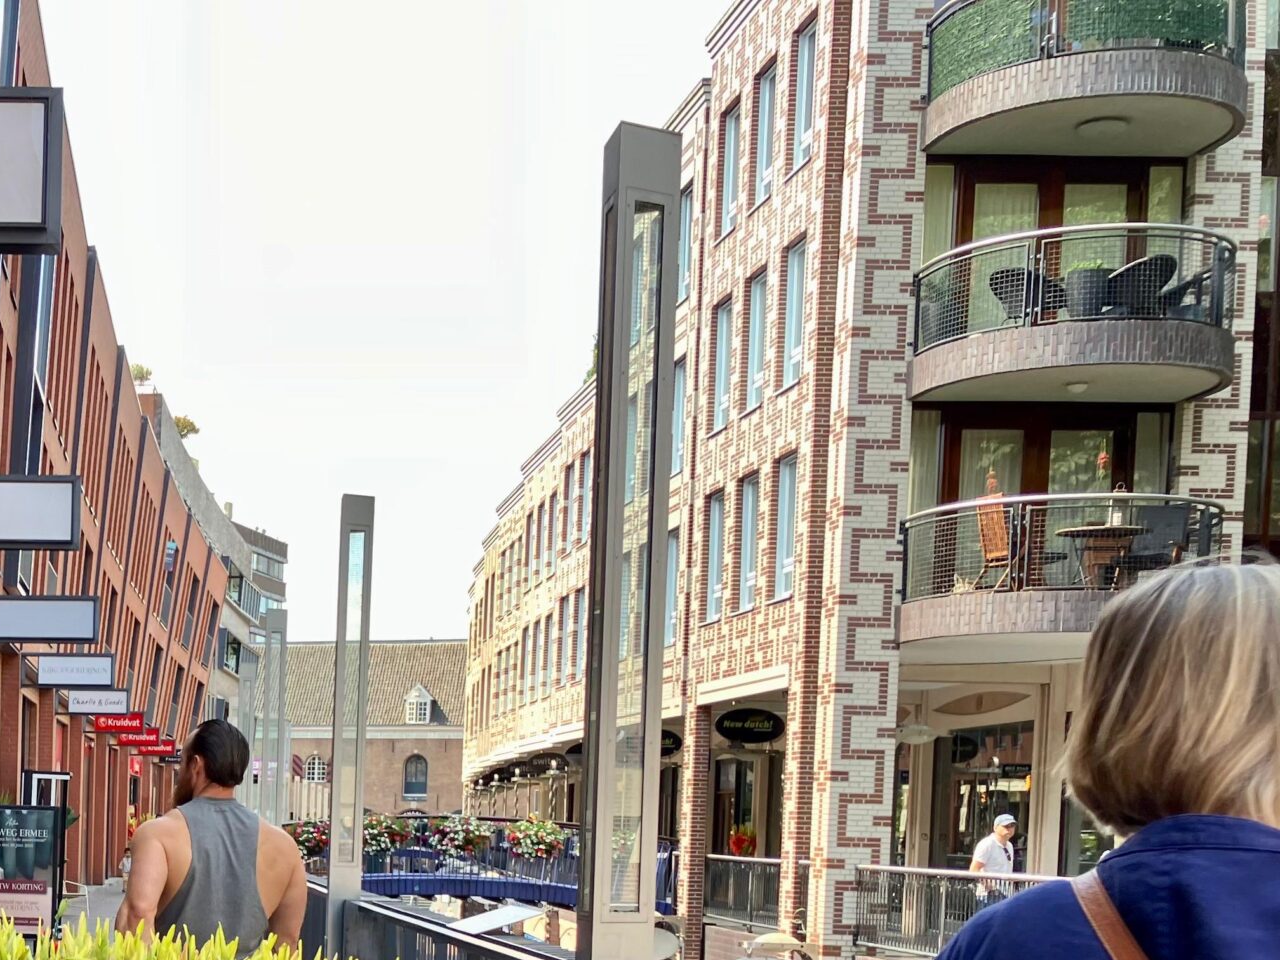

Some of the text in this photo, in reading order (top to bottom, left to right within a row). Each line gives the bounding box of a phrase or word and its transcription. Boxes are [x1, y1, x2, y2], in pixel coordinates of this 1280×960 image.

[108, 718, 140, 727] Kruidvat
[128, 733, 157, 741] Kruidvat
[19, 829, 49, 838] ERMEE
[11, 883, 43, 891] KORTING
